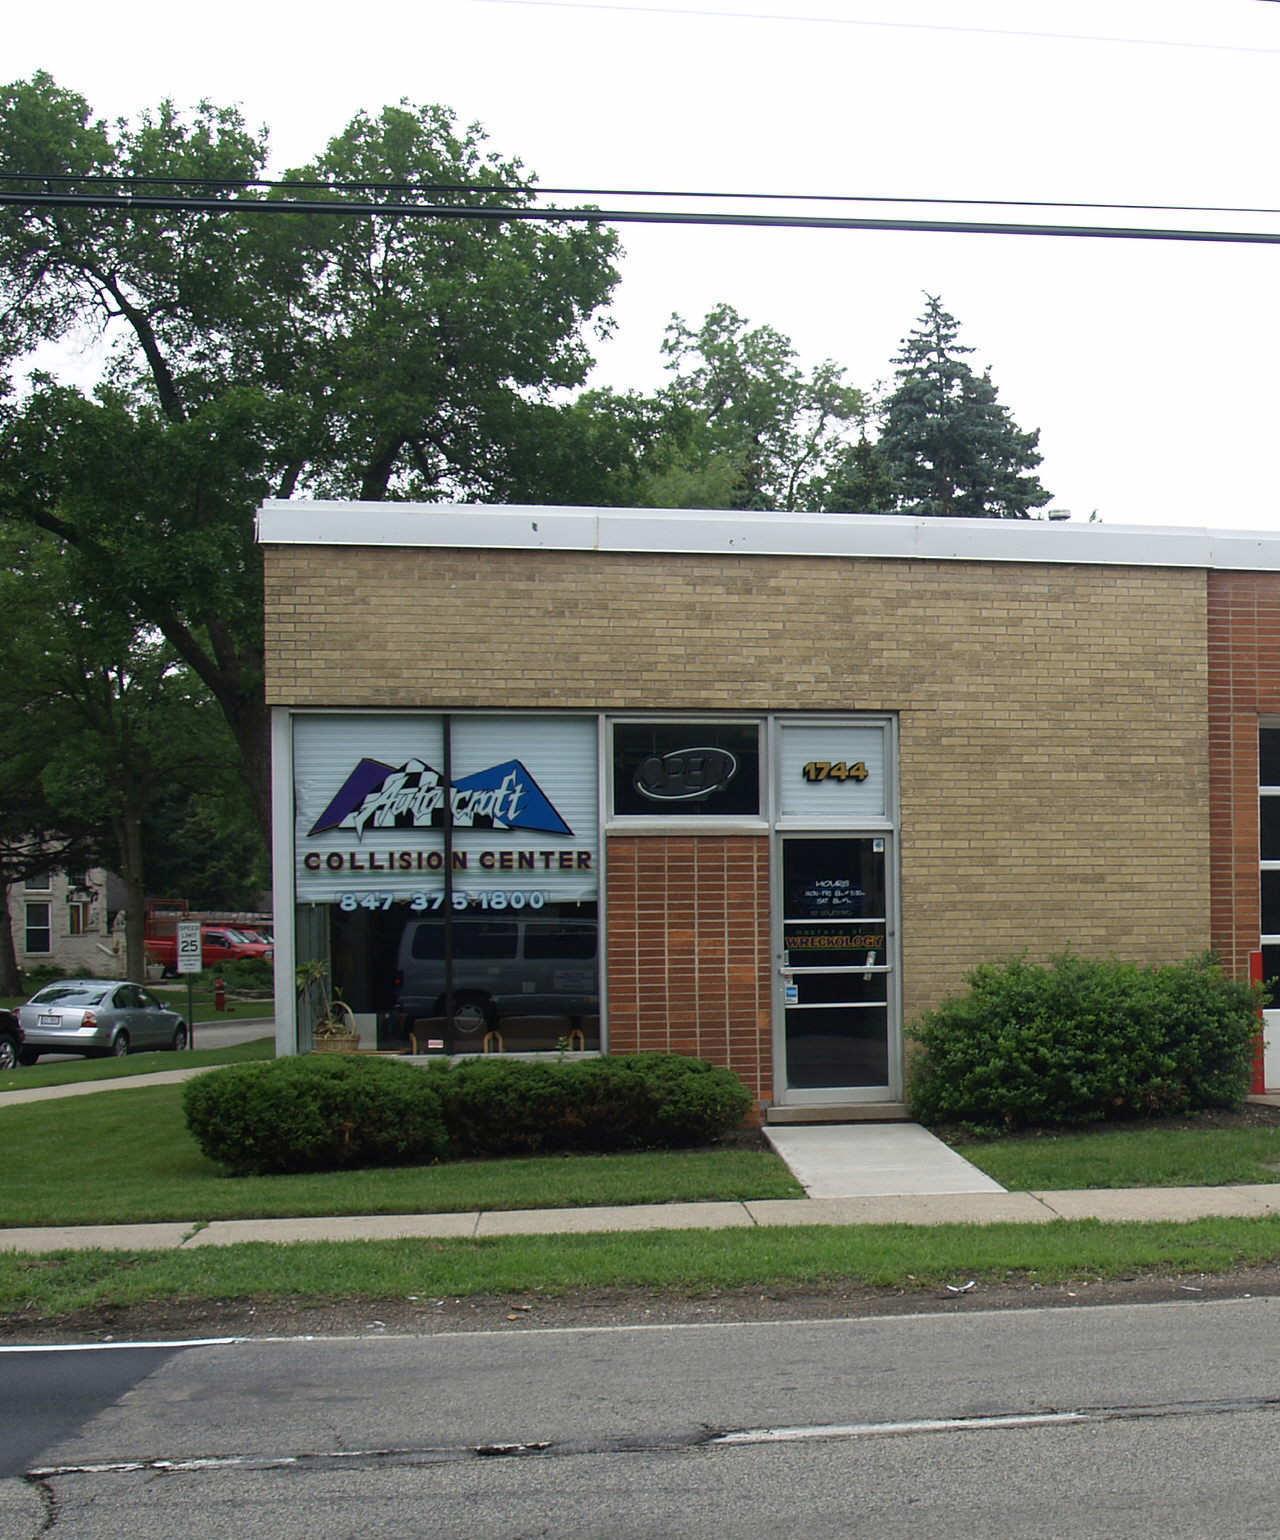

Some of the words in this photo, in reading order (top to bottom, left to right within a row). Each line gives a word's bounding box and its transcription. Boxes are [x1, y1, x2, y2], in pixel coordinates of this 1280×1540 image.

[802, 761, 869, 783] 1744
[354, 768, 529, 844] Autocraft
[304, 851, 468, 871] COLLISION
[479, 851, 593, 870] CENTER
[339, 892, 395, 911] 847
[181, 940, 198, 952] 25
[785, 934, 885, 949] WRECKOLOGY
